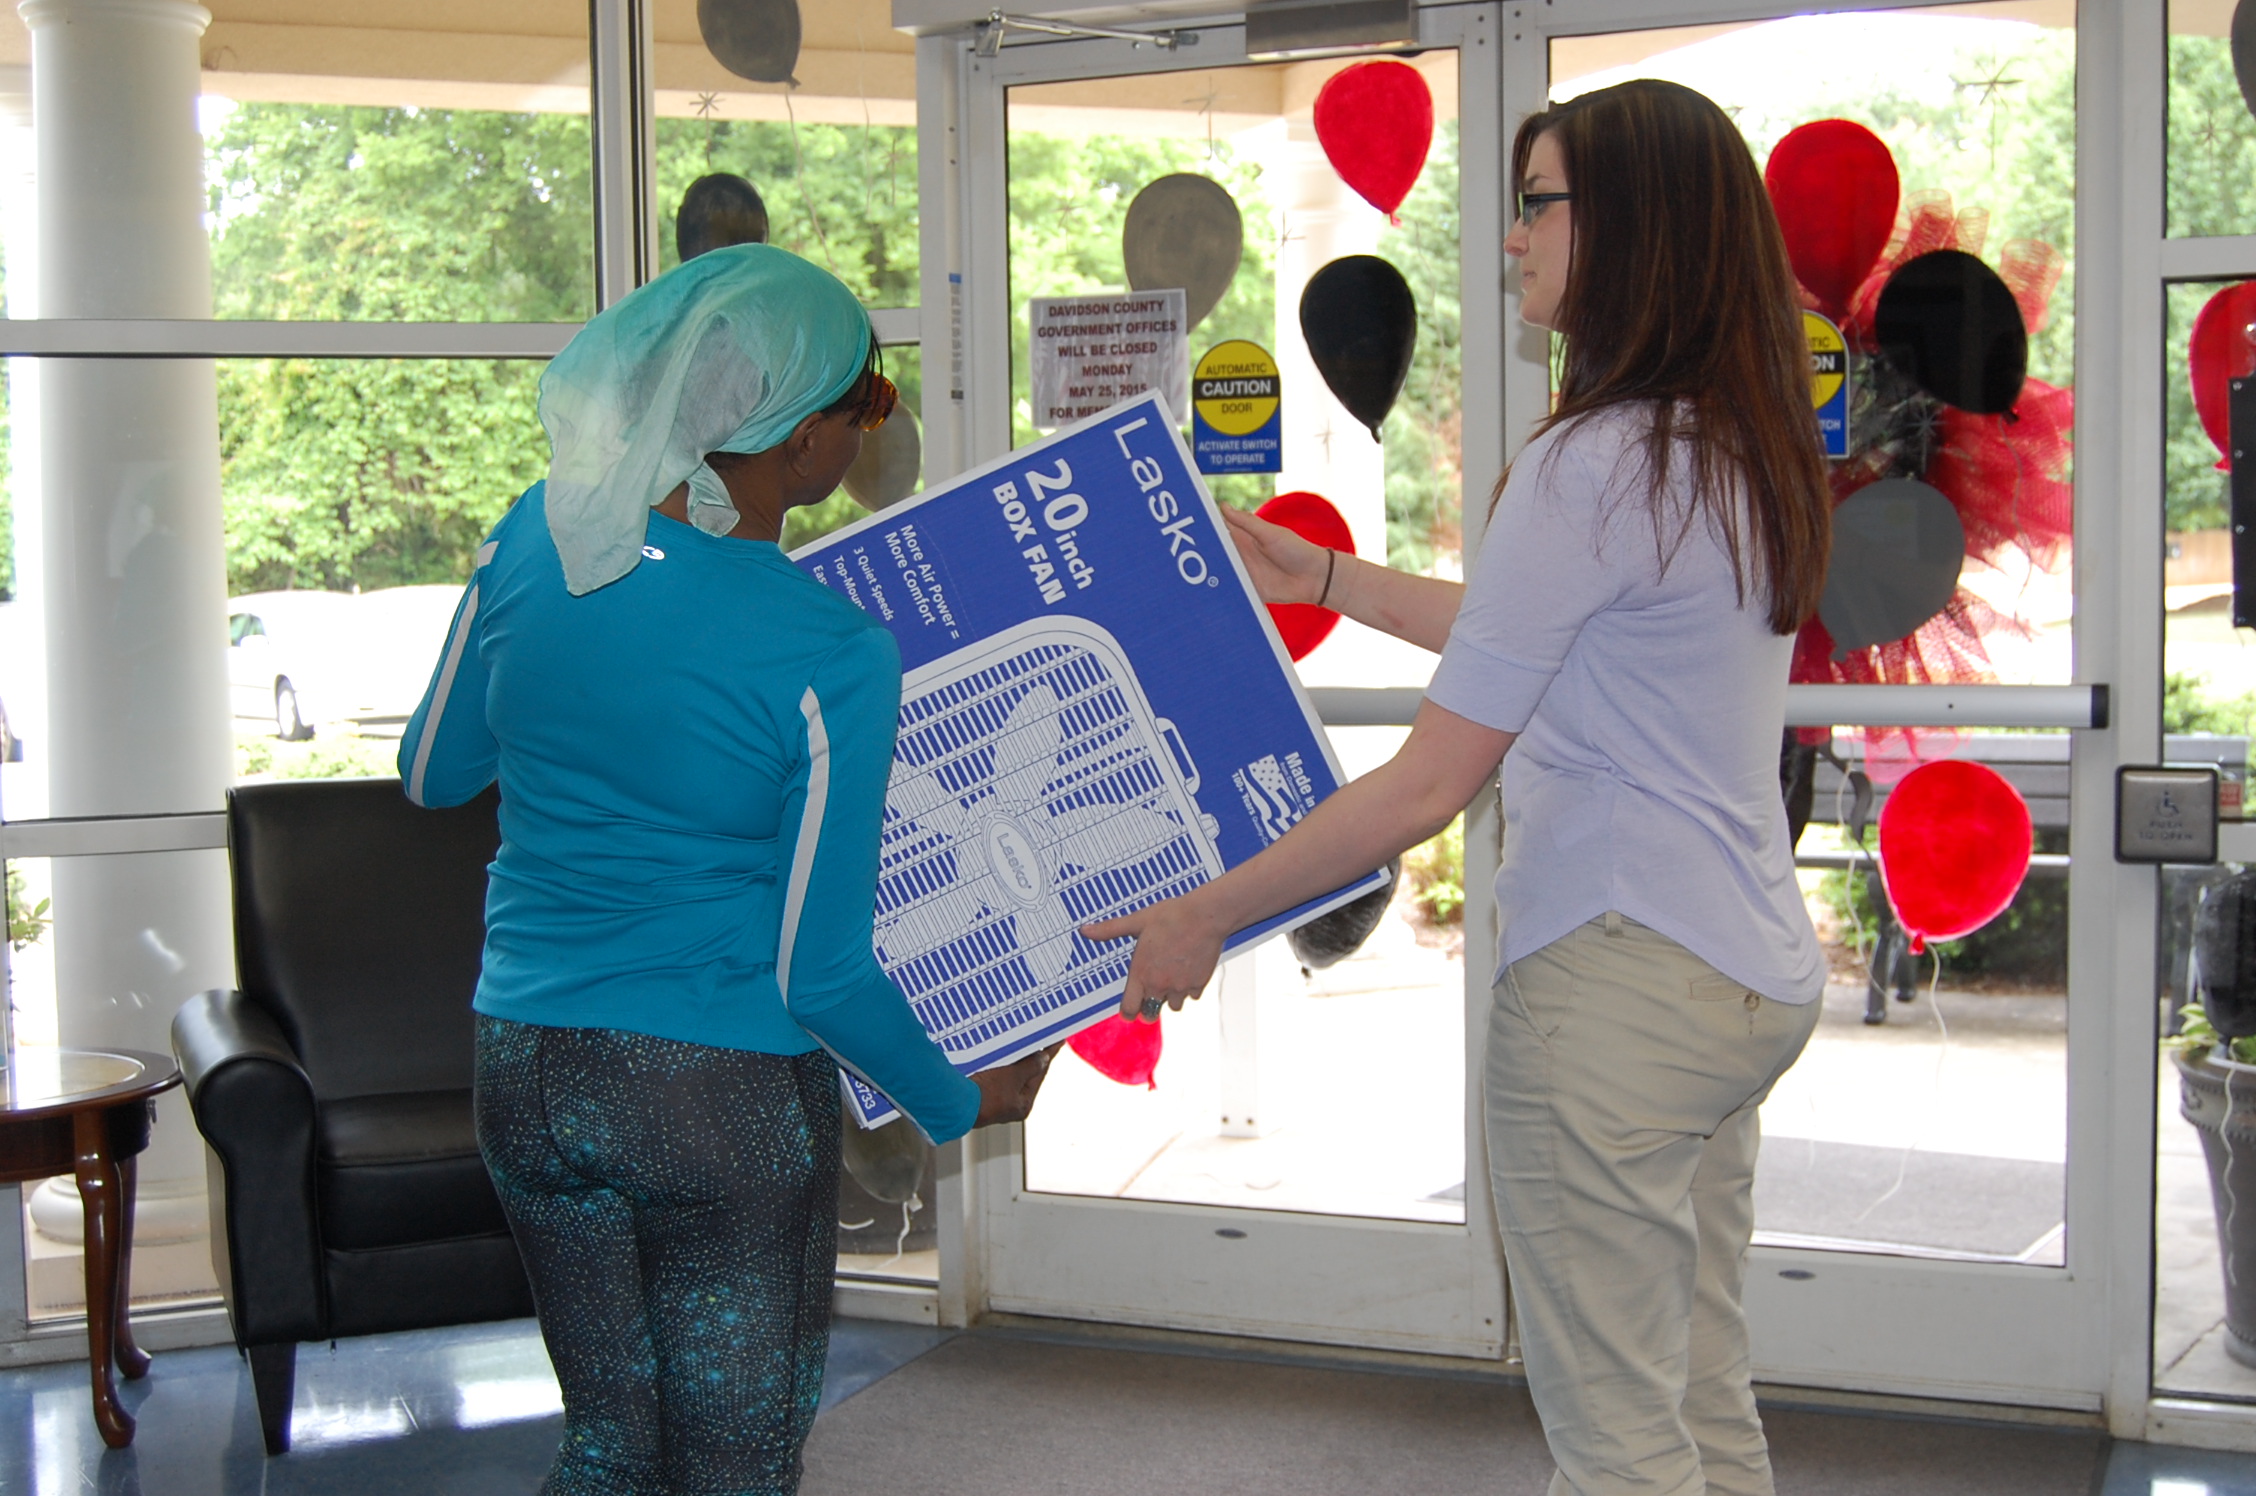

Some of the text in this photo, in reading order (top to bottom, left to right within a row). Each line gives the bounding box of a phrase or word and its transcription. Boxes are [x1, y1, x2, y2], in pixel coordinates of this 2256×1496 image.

[1049, 300, 1164, 317] DAVIDSON COUNTY
[1038, 320, 1177, 338] GOVERNMENT OFFICES
[1058, 342, 1157, 357] WILL BE CLOSED
[1082, 364, 1132, 376] MONDAY
[1206, 363, 1267, 375] AUTOMATIC
[1069, 383, 1147, 398] MAY 25, 2015
[1202, 379, 1271, 396] CAUTION
[1049, 406, 1073, 418] FOR
[1221, 402, 1252, 413] DOOR
[1199, 439, 1277, 451] ACTIVATE SWITCH
[1211, 453, 1265, 464] TO OPERATE
[1114, 417, 1208, 585] Lasko
[1025, 458, 1095, 590] 20 inch
[992, 481, 1067, 605] BOX FAN
[834, 555, 866, 609] Top-Moun
[853, 546, 895, 621] 3 Quiet Speeds
[884, 531, 936, 625] More Comfort
[900, 524, 924, 561] More
[918, 563, 936, 583] Air
[929, 584, 956, 627] Power
[1284, 751, 1316, 808] Made in
[1231, 772, 1244, 793] 100+
[1242, 792, 1256, 816] Years
[997, 832, 1029, 889] Lasko
